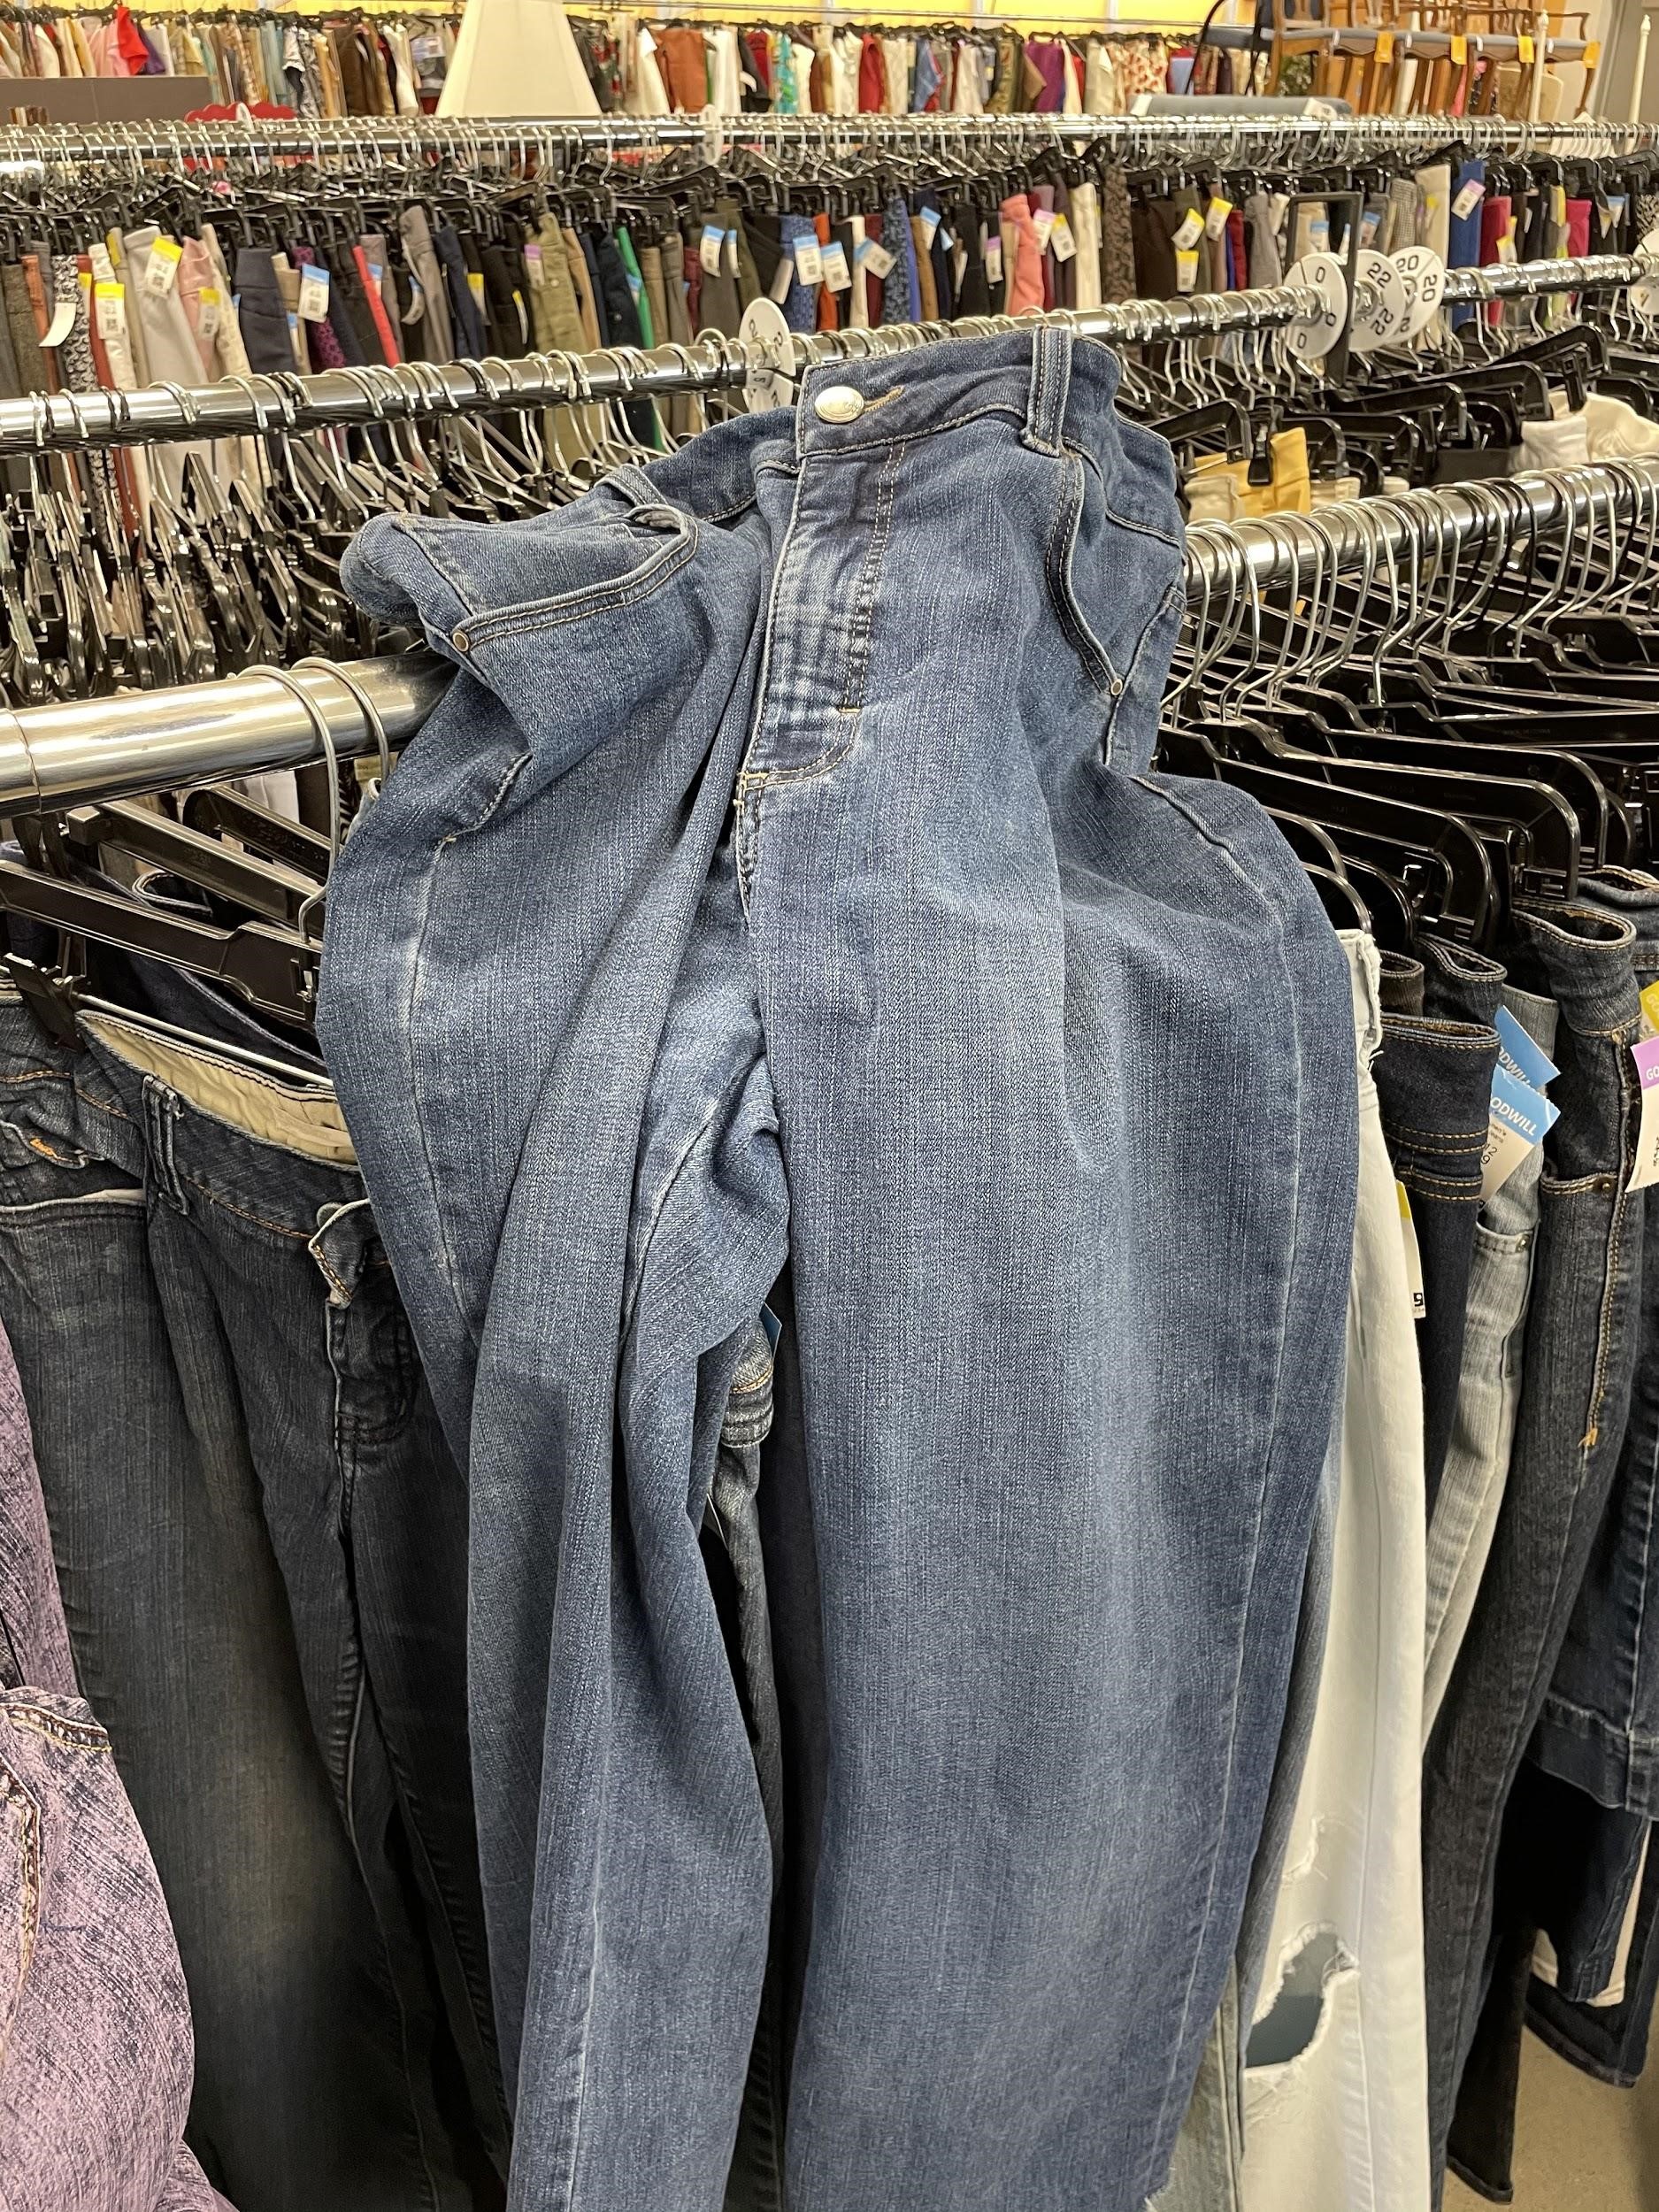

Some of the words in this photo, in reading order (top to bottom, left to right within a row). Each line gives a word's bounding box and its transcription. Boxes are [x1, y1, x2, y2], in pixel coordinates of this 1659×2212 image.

[1366, 262, 1392, 288] 22
[1422, 274, 1438, 303] 20
[1370, 308, 1394, 336] 22
